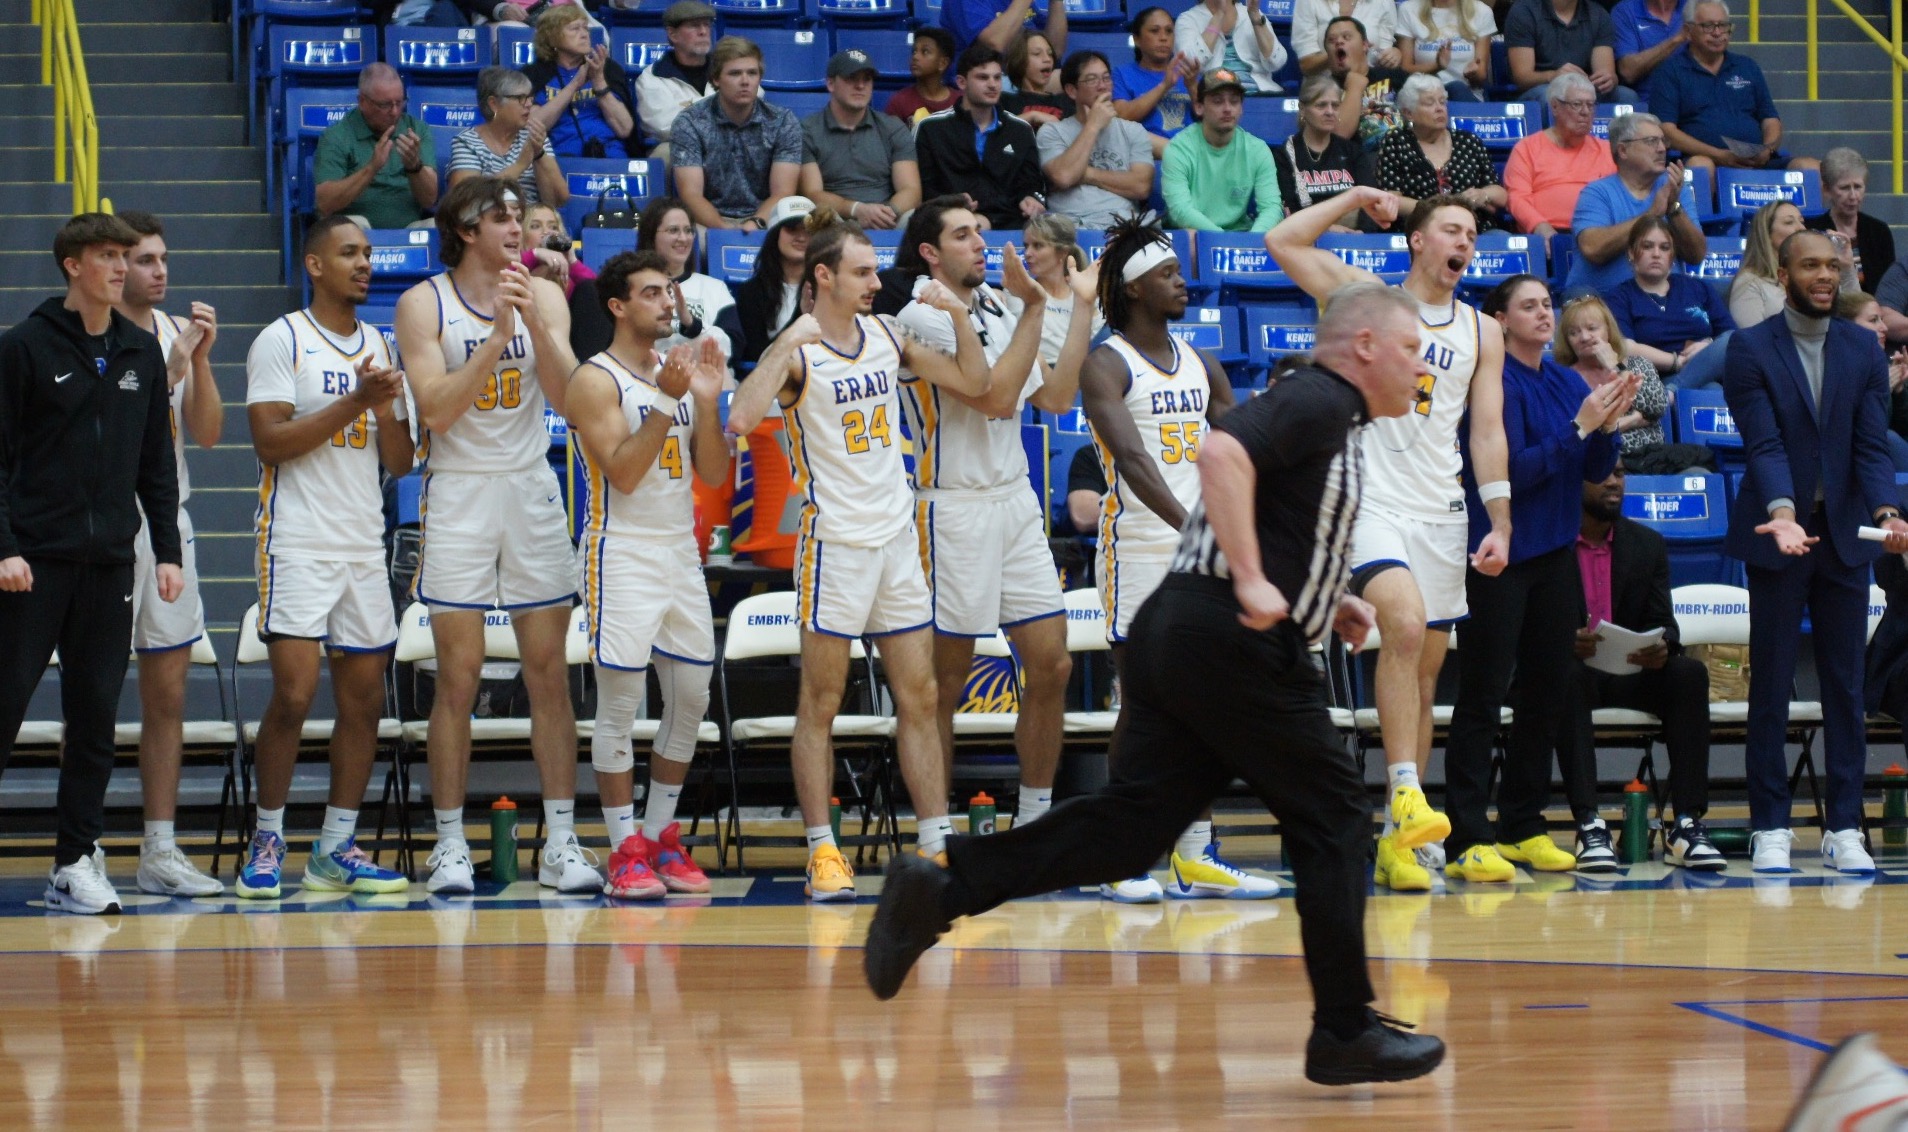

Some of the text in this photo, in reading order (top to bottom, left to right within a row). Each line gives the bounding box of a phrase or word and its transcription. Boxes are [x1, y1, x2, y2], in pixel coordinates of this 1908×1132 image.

[1268, 1, 1290, 9] FRITZ
[326, 112, 346, 120] RAV
[446, 111, 475, 120] RAVEN
[1474, 124, 1501, 132] PARKS
[1301, 168, 1354, 185] AMPA
[1233, 255, 1267, 265] OAKLEY
[1353, 256, 1387, 266] OAKLEY
[1471, 258, 1504, 268] OAKLEY
[1703, 259, 1740, 268] CARLTON
[464, 334, 526, 362] EAU
[1424, 342, 1455, 370] AU
[473, 367, 521, 411] 30
[832, 370, 889, 404] ERAU
[1151, 388, 1203, 415] ERAU
[638, 402, 690, 428] EAU
[842, 404, 892, 455] 24
[1159, 421, 1201, 464] 55
[659, 435, 683, 479] 4
[1644, 501, 1680, 512] RDDER
[1674, 603, 1749, 615] MBRY-RIDDL
